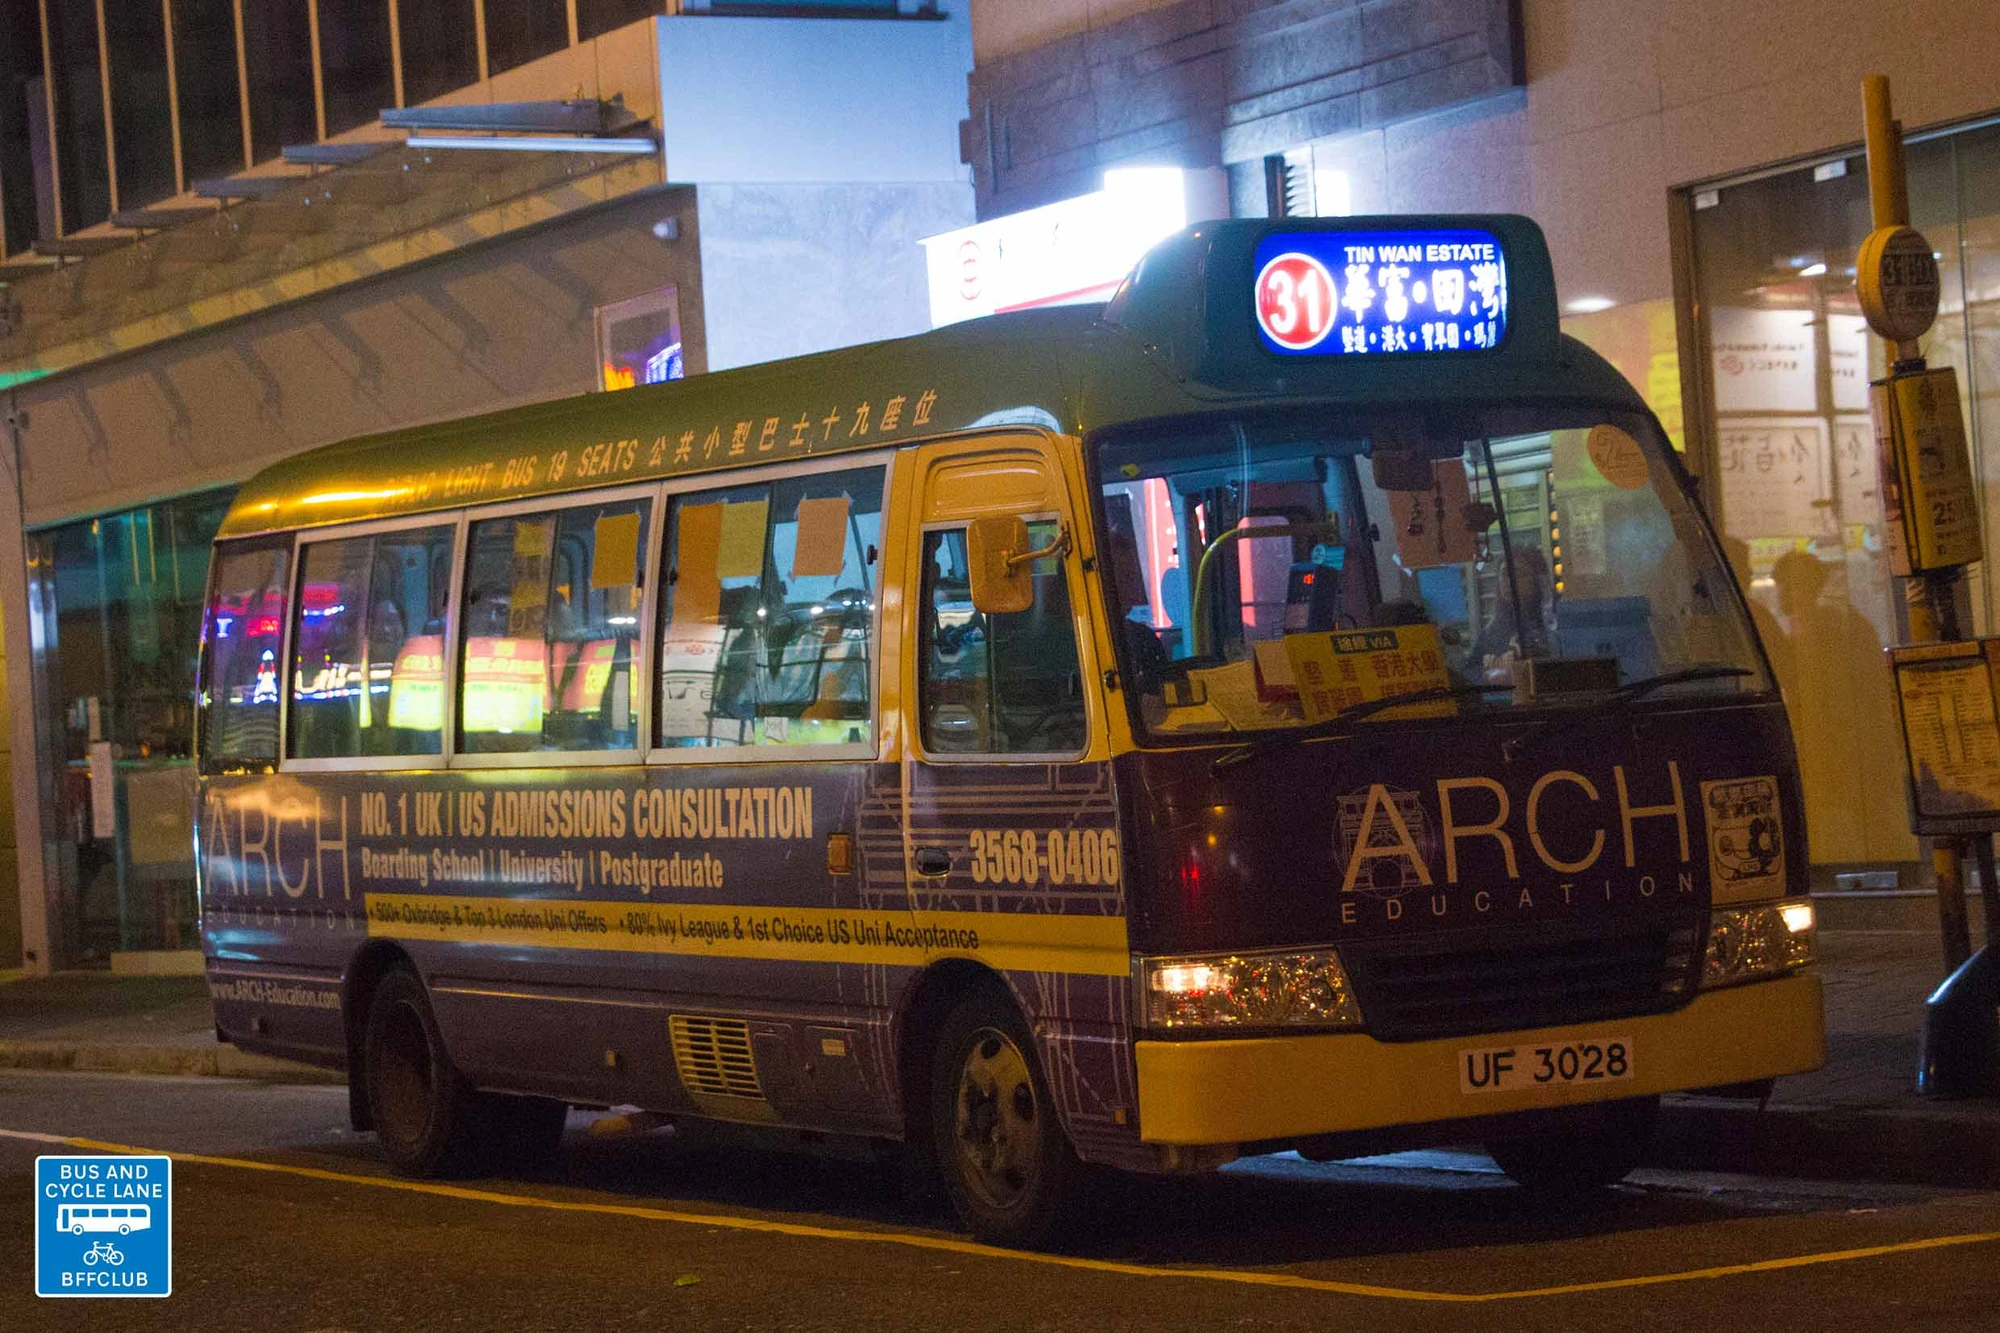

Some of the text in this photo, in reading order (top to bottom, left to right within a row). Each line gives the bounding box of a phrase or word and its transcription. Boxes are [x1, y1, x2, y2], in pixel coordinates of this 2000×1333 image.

[1344, 243, 1495, 263] TIN WAN ESTATE
[1267, 268, 1320, 334] 31
[647, 388, 938, 467] 公共小型巴士十九座位
[444, 462, 496, 497] LIGHT
[502, 455, 538, 489] BUS
[547, 450, 568, 482] 19
[577, 439, 639, 477] SEATS
[361, 791, 392, 836] NO.
[398, 791, 408, 836] 1
[415, 791, 443, 837] UK
[459, 790, 486, 838] US
[490, 788, 627, 839] ADMISSIONS
[633, 787, 813, 839] CONSULTATION
[1340, 760, 1691, 893] ARCH
[205, 796, 351, 900] ARCH
[361, 847, 429, 888] Boarding
[432, 848, 485, 882] School
[500, 849, 584, 892] University
[600, 850, 724, 895] Postgraduate
[969, 828, 1119, 885] 3568-0406
[402, 903, 451, 931] Oxbridge
[453, 905, 462, 926] &
[464, 905, 485, 933] Top
[498, 906, 542, 930] London
[546, 908, 567, 933] Uni
[569, 910, 608, 935] Offers
[1342, 872, 1693, 924] EDUCATION
[658, 912, 677, 944] Ivy
[680, 914, 729, 946] League
[733, 916, 743, 940] &
[748, 917, 769, 942] 1st
[772, 916, 824, 945] Choice
[827, 918, 850, 945] US
[853, 919, 882, 947] Uni
[885, 921, 980, 953] Acceptance
[1467, 1043, 1628, 1087] UF 3028
